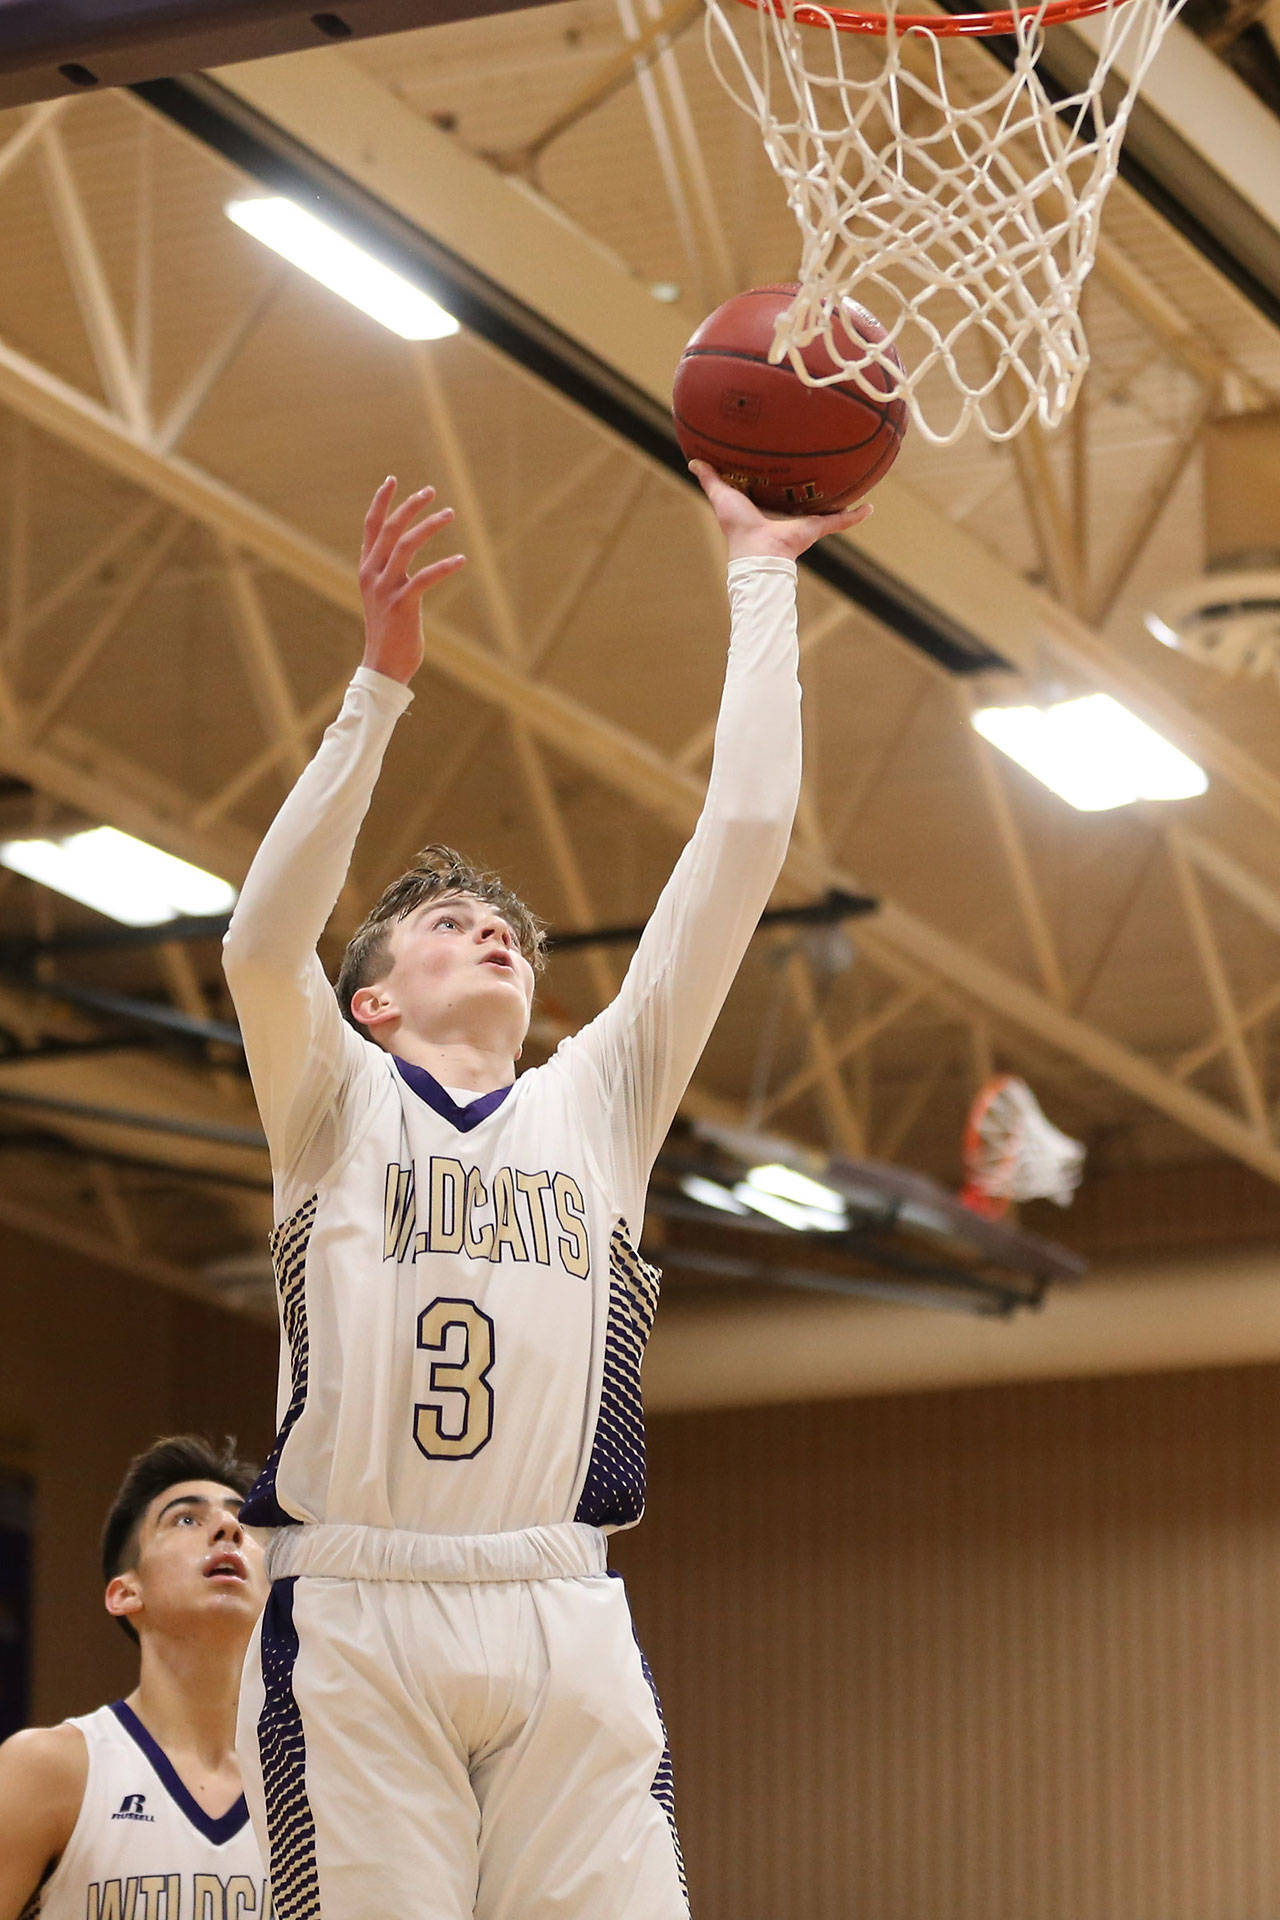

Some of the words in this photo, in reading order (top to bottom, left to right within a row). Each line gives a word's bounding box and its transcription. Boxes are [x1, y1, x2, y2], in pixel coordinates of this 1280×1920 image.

[383, 1156, 590, 1280] WDCATS
[413, 1297, 495, 1461] 3
[111, 1813, 155, 1823] RUSSELL
